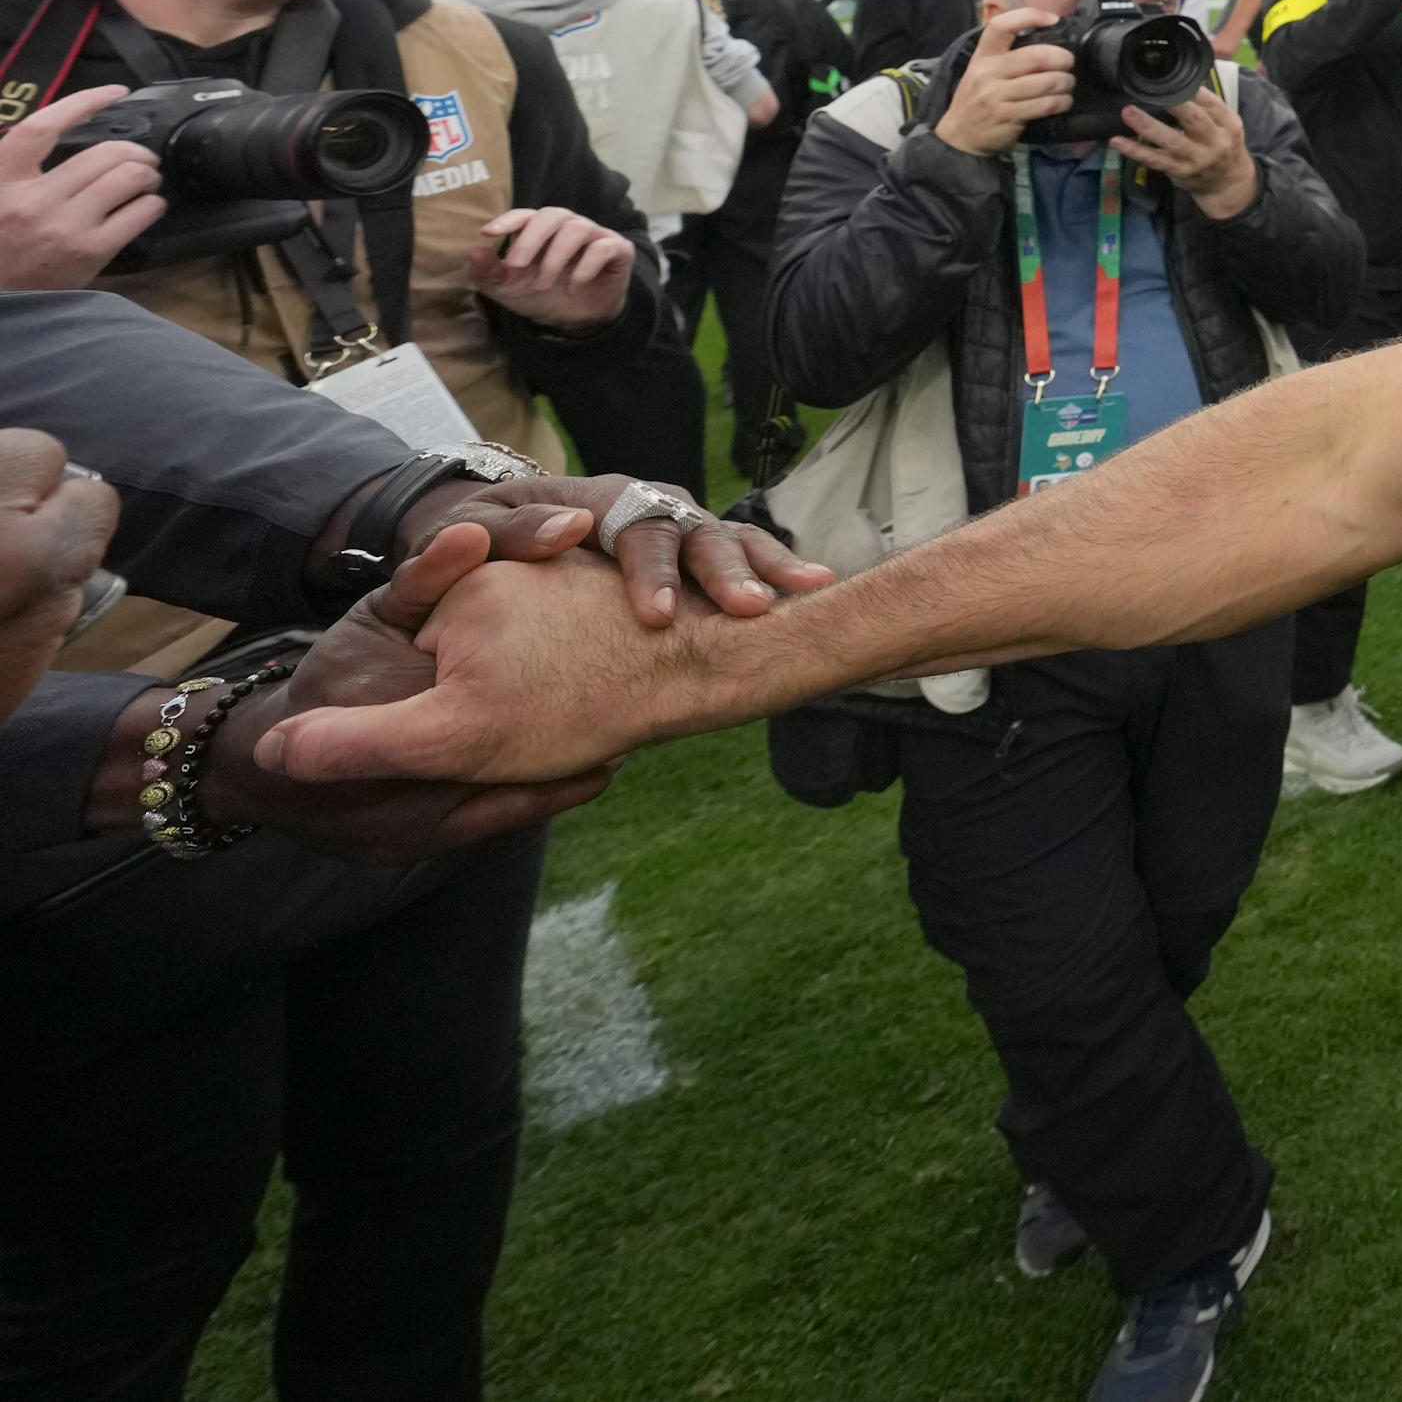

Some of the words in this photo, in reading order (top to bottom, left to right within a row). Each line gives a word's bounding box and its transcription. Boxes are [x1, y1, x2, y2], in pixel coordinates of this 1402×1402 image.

[557, 53, 613, 81] DIA
[0, 80, 39, 125] OS
[426, 118, 462, 153] FL
[410, 159, 491, 197] MEDIA
